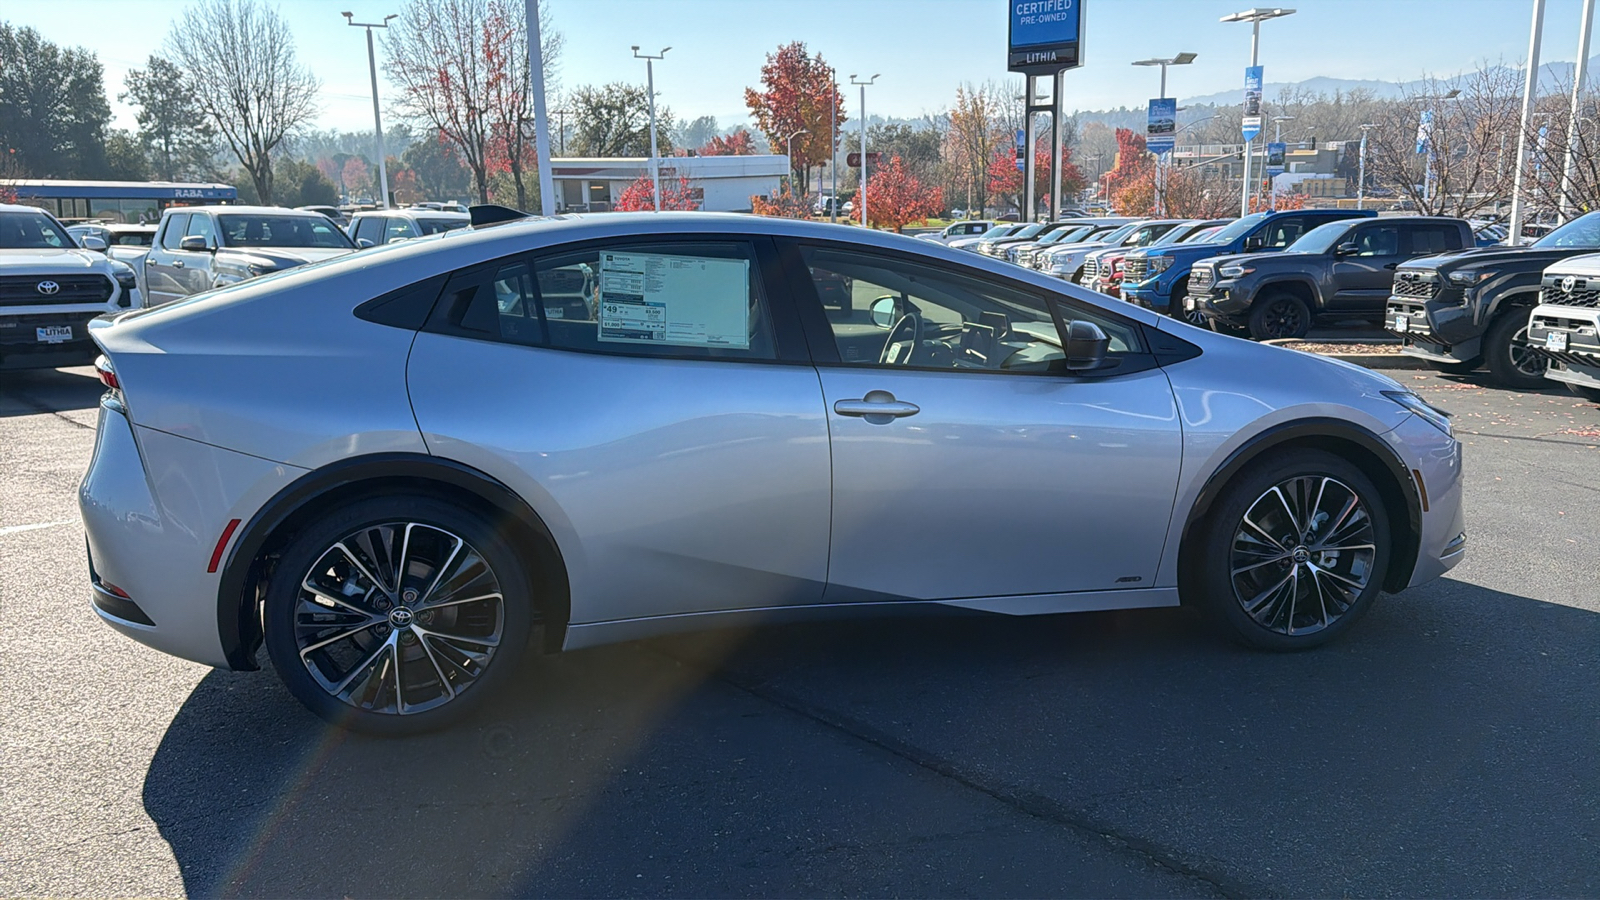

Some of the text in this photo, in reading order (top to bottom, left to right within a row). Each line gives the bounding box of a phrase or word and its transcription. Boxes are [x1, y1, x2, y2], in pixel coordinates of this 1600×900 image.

[1016, 0, 1072, 15] CERTIFIED
[1020, 12, 1067, 25] PRE-OWNED
[1026, 51, 1057, 63] LITHIA
[175, 189, 204, 198] RABA
[606, 305, 618, 313] 49
[45, 328, 71, 336] LITHIA
